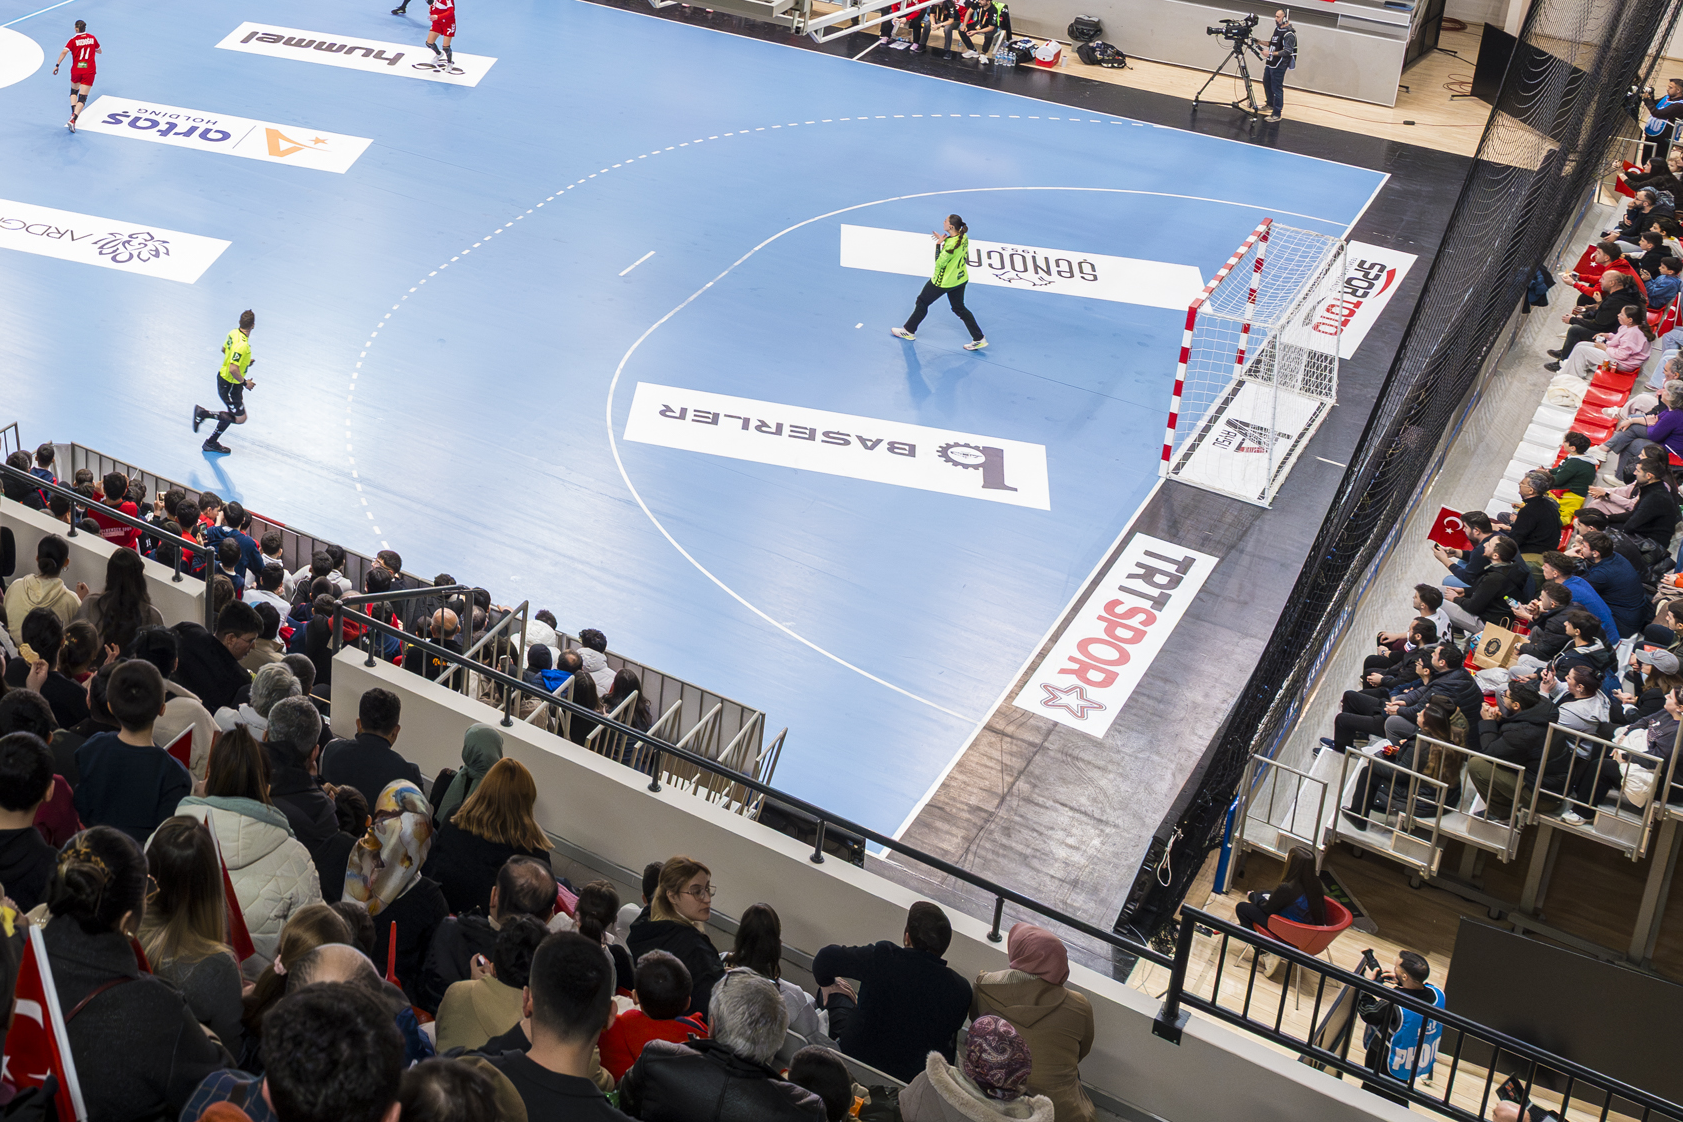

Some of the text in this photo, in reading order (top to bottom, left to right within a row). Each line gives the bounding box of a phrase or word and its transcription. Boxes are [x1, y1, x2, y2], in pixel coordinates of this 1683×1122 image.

[239, 30, 406, 66] hummel
[101, 110, 232, 143] artaş
[1000, 246, 1039, 256] 1953
[657, 402, 917, 459] BAŞERLER
